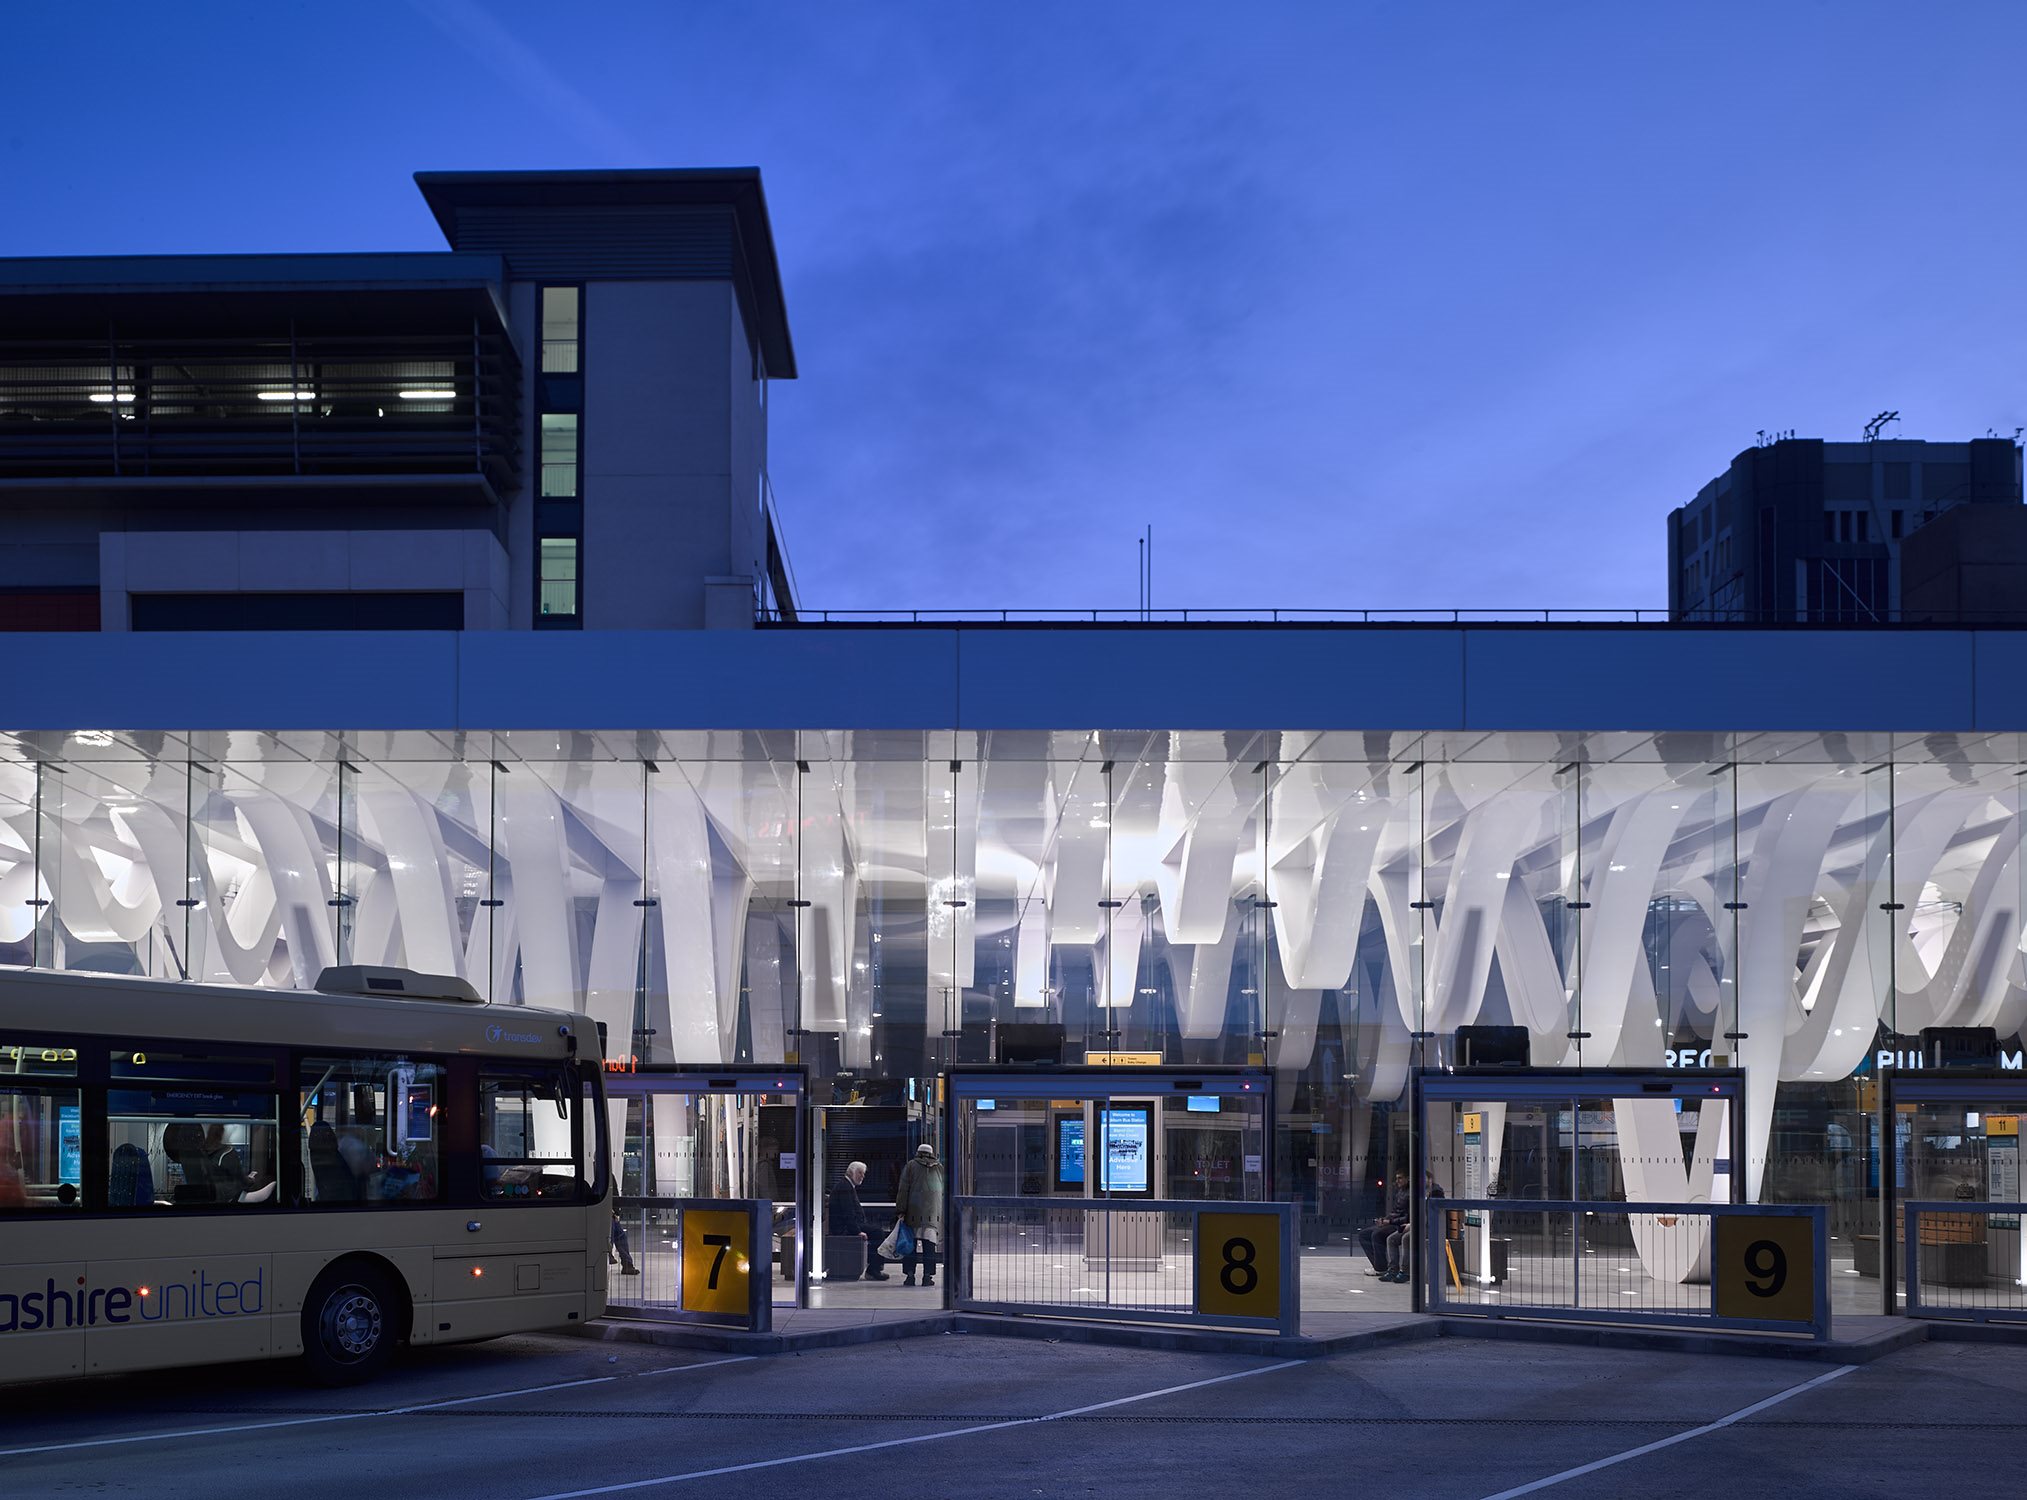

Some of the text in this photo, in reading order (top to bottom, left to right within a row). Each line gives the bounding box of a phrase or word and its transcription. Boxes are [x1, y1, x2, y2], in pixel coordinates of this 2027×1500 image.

[503, 1031, 543, 1043] transdev
[1998, 1120, 2006, 1131] 11
[702, 1233, 732, 1290] 7
[1219, 1236, 1259, 1295] 8
[1743, 1239, 1788, 1298] 9
[140, 1266, 263, 1321] united
